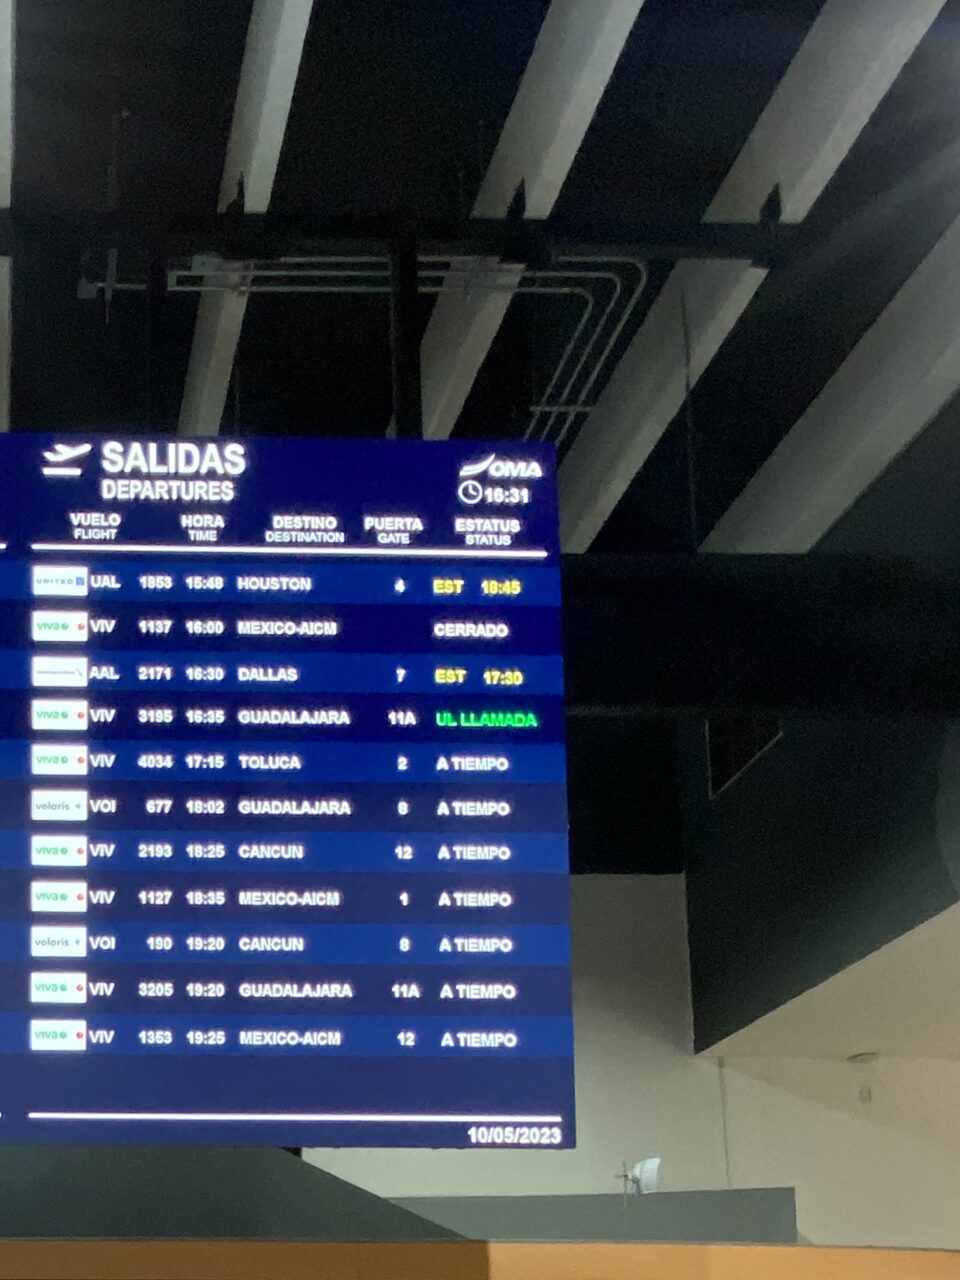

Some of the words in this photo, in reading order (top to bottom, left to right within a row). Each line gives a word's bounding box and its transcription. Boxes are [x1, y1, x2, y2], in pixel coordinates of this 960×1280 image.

[102, 441, 245, 475] SALIDAS
[489, 460, 542, 477] OMA
[102, 479, 234, 501] DEPARTURES
[484, 487, 528, 503] 16:31
[70, 513, 121, 526] VUELO
[181, 514, 224, 528] HORA
[273, 516, 337, 529] DESTINO
[364, 517, 423, 531] PUERTA
[456, 519, 520, 532] ESTATUS
[74, 528, 117, 539] FLIGHT
[188, 530, 217, 541] TIME
[266, 531, 344, 542] DESTINATION
[377, 533, 410, 544] GATE
[465, 535, 511, 546] STATUS
[90, 620, 115, 633] VIV
[139, 620, 172, 633] 1137
[186, 621, 224, 634] 16:00
[238, 621, 337, 635] MEXICO-AICM
[434, 623, 508, 637] CERRADO
[90, 667, 119, 680] AAL
[139, 667, 171, 680] 2171
[186, 667, 224, 680] 16:30
[238, 667, 298, 681] DALLAS
[396, 669, 405, 682] 7
[435, 669, 466, 683] EST
[484, 671, 523, 685] 17:30
[90, 710, 115, 723] VIV
[139, 709, 173, 722] 3195
[186, 710, 224, 723] 16:35
[238, 710, 350, 724] GUADALAJARA
[389, 711, 416, 725] 11A
[436, 713, 457, 726] UL
[460, 713, 537, 727] LLAMADA
[90, 754, 115, 768] VIV
[138, 755, 173, 768] 4034
[186, 755, 224, 768] 17:15
[239, 755, 301, 769] TOLUCA
[398, 757, 407, 770] 2
[437, 757, 449, 770] A
[451, 757, 509, 771] TIEMPO
[90, 891, 115, 904] VIV
[139, 891, 172, 904] 1127
[186, 891, 225, 905] 18:35
[239, 891, 340, 905] MEXICO-AICM
[400, 892, 408, 905] 1
[439, 892, 451, 906] A
[453, 892, 512, 907] TIEMPO
[90, 937, 116, 950] VOI
[147, 937, 172, 950] 190
[186, 937, 225, 950] 19:20
[239, 937, 304, 951] CANCUN
[439, 938, 451, 952] A
[454, 938, 512, 952] TIEMPO
[89, 1031, 115, 1044] VIV
[139, 1030, 172, 1044] 1353
[187, 1031, 225, 1044] 19:25
[240, 1031, 341, 1045] MEXICO-AICM
[397, 1032, 415, 1046] 12
[441, 1032, 454, 1046] A
[457, 1032, 517, 1047] TIEMPO
[468, 1126, 561, 1144] 10/05/2023
